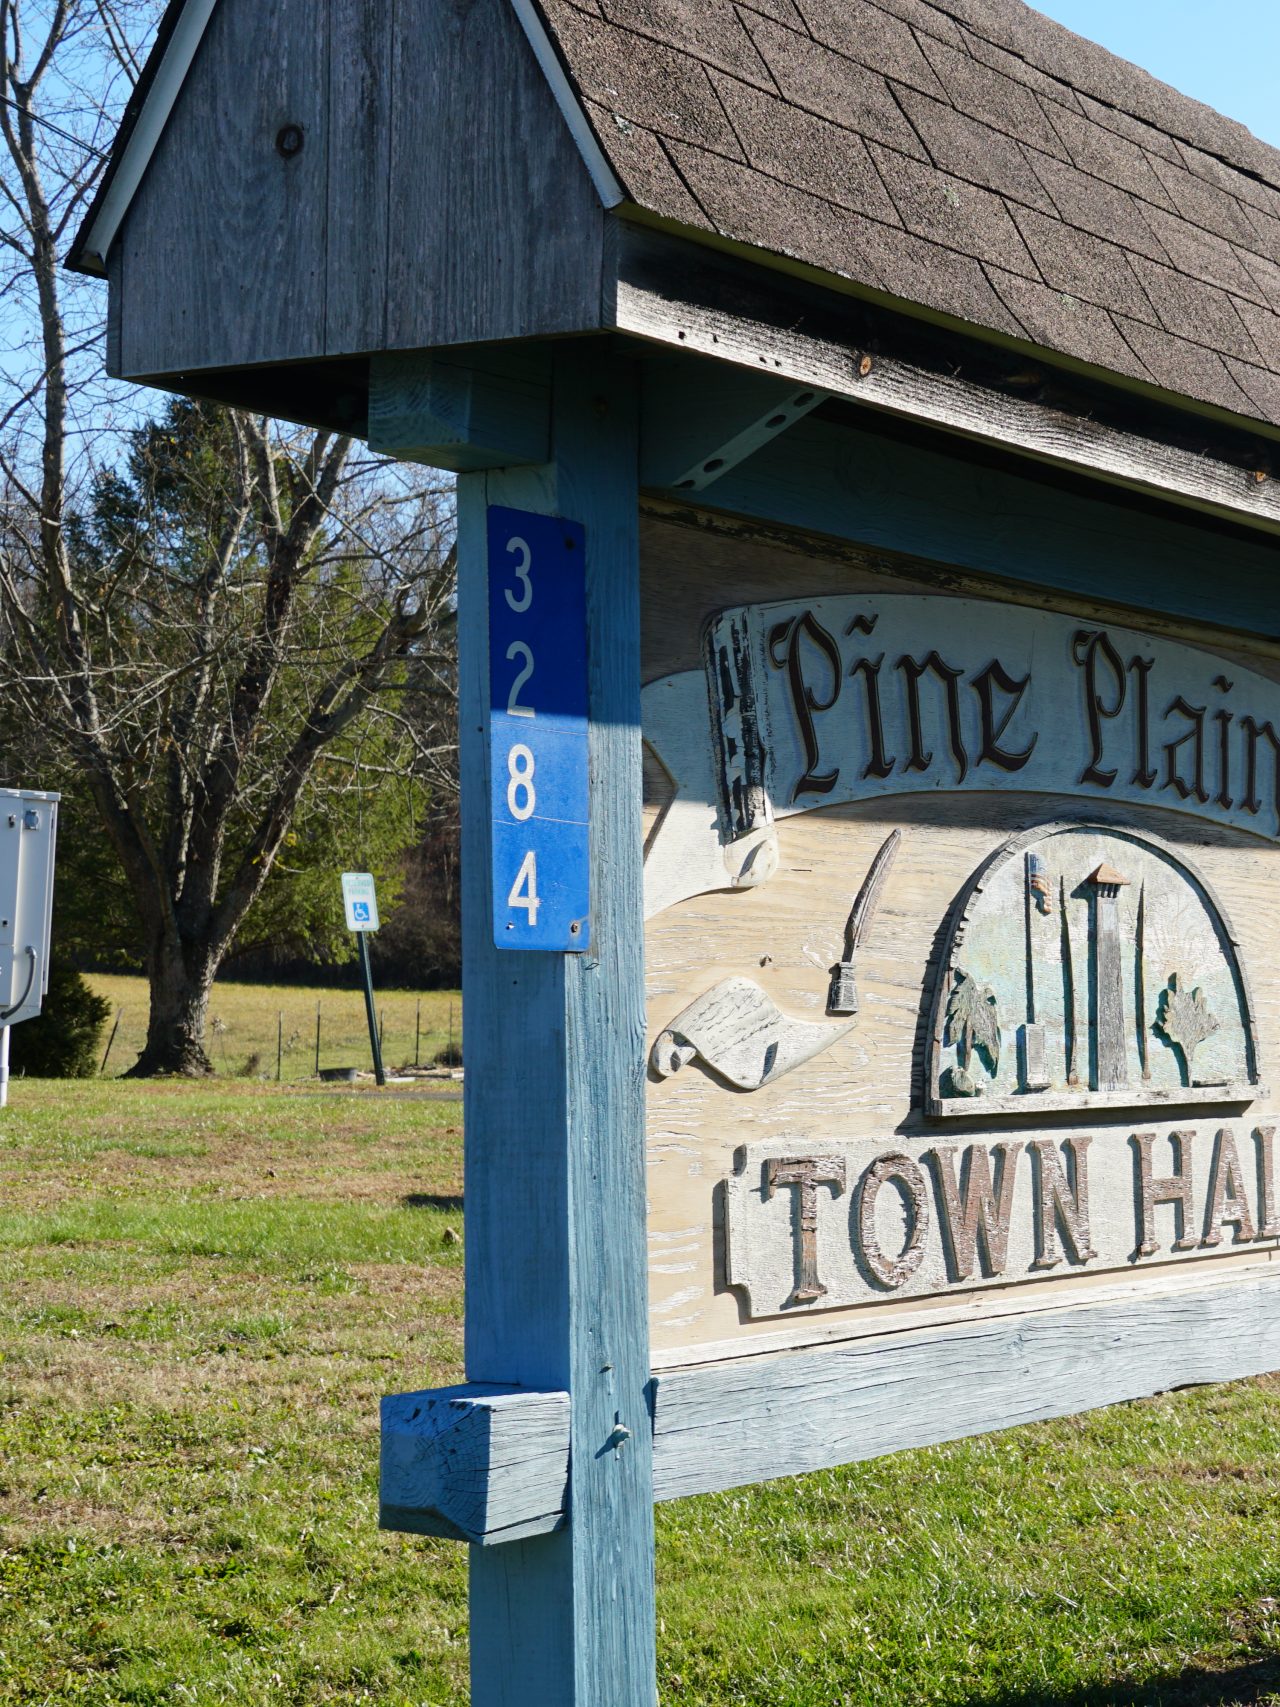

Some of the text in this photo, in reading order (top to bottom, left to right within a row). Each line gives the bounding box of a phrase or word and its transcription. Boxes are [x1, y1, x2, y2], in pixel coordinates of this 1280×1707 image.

[504, 535, 540, 926] 3284
[771, 610, 1039, 799] Pine
[767, 1134, 1098, 1303] TOWN
